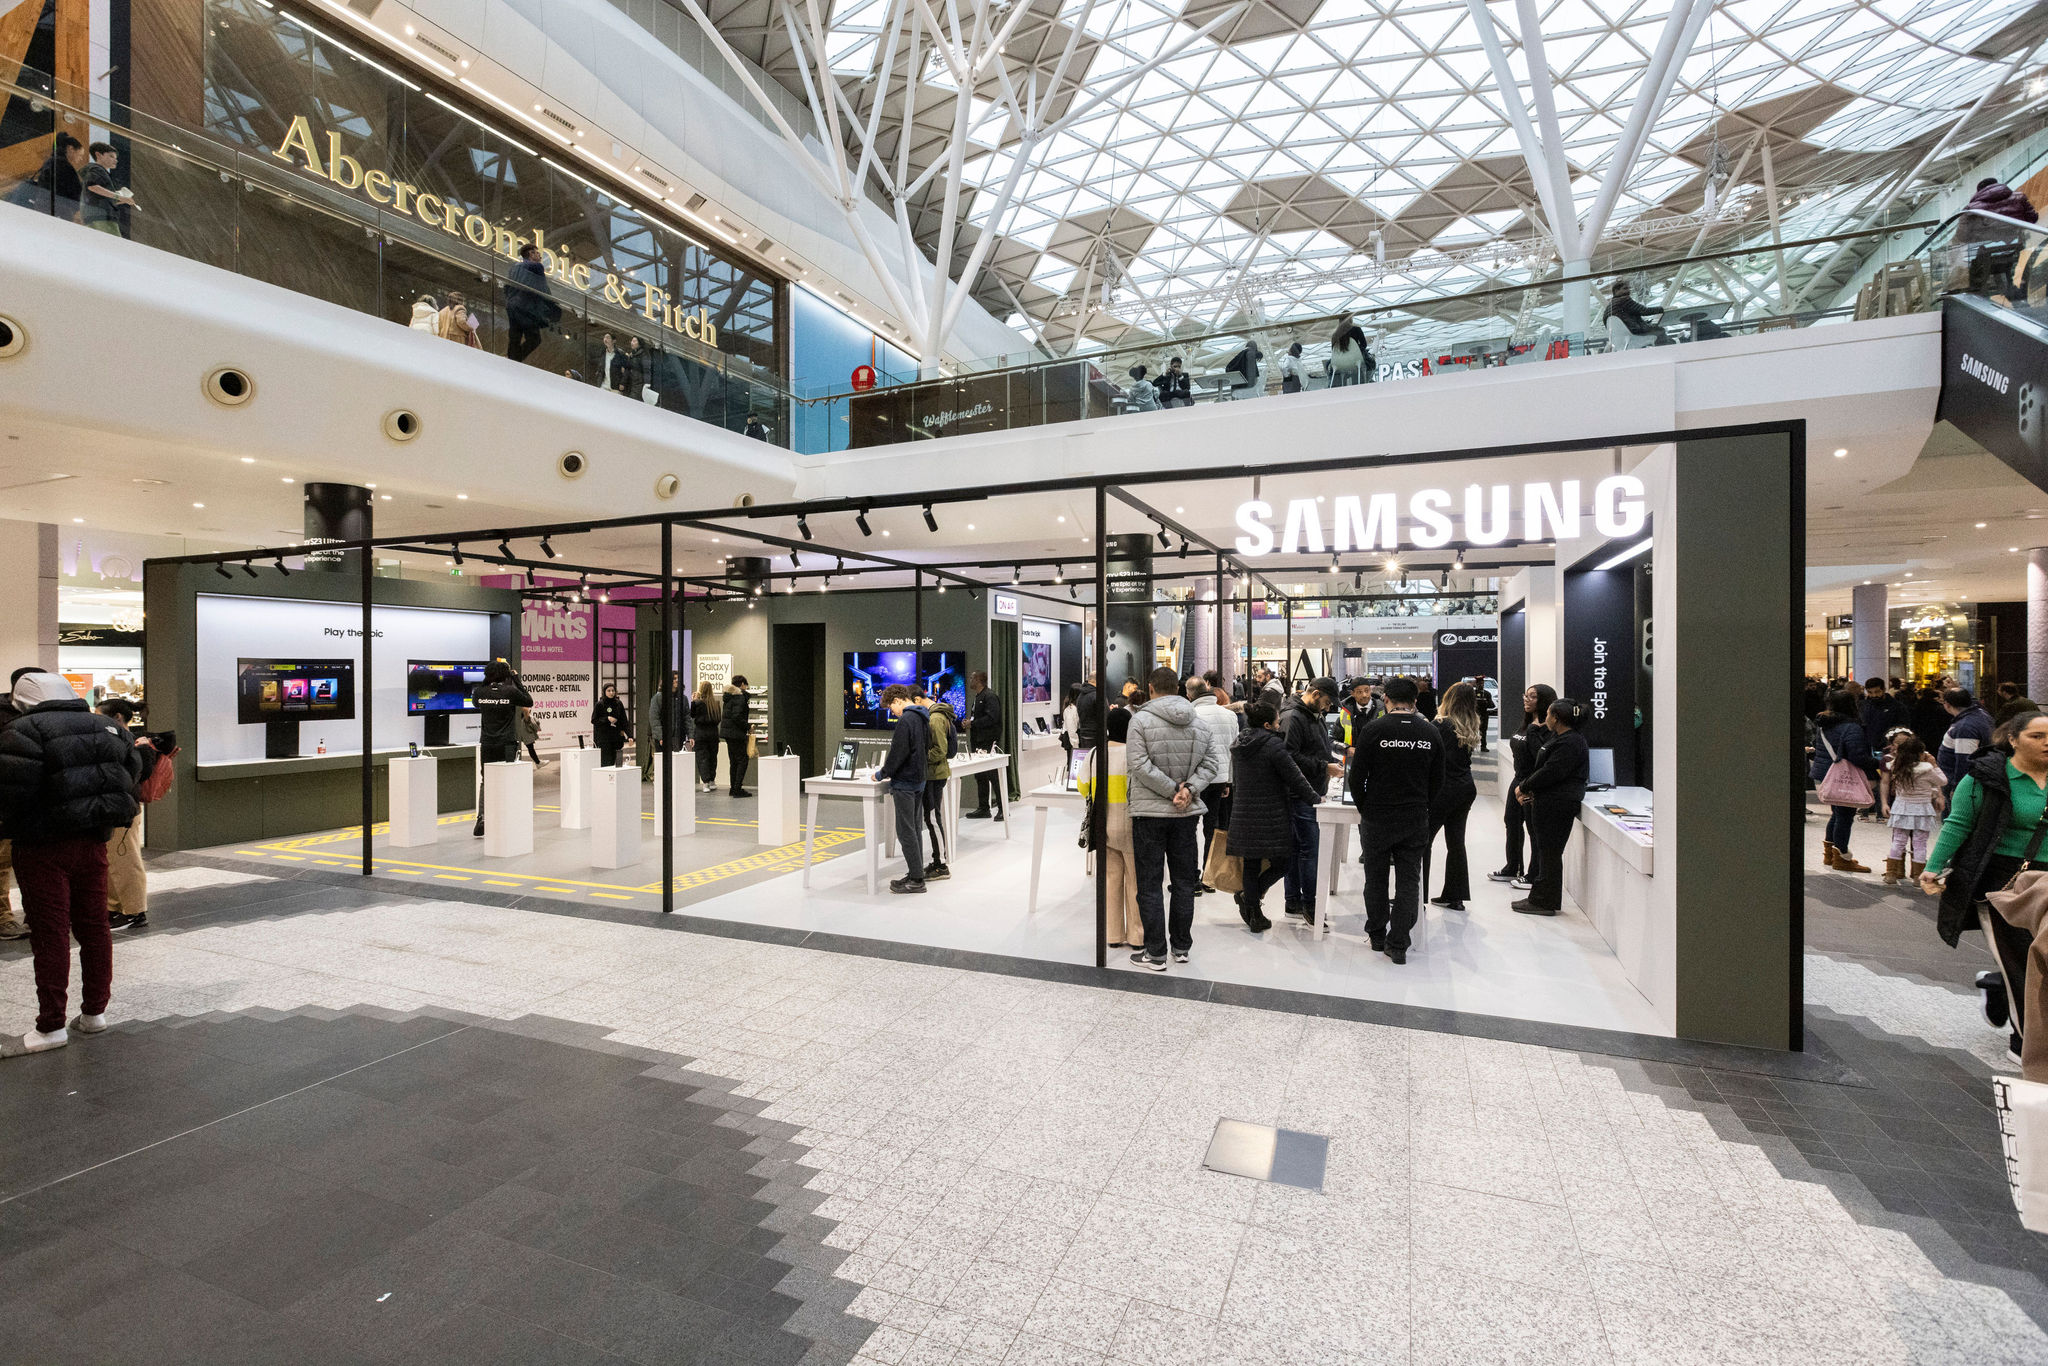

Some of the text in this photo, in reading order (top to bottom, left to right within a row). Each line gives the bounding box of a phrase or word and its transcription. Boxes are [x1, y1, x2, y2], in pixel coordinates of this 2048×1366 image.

[272, 115, 719, 348] Abercrombie & Fitch
[1961, 353, 2010, 395] SAMSUNG
[1235, 474, 1645, 557] SAMSUNG
[521, 609, 588, 642] Mutts
[324, 627, 345, 639] Play
[347, 628, 363, 637] the
[874, 636, 934, 647] Capture the pic
[698, 662, 730, 674] Galaxy
[521, 673, 590, 682] OOMING BOARDING
[699, 672, 724, 681] Photo
[1590, 637, 1609, 719] Join the Epic
[559, 684, 582, 692] RETAIL
[534, 701, 544, 709] 24
[545, 700, 569, 709] HOURS
[576, 699, 589, 707] DAY
[552, 711, 558, 719] A
[558, 710, 578, 719] WEEK
[1379, 739, 1432, 750] Galaxy S23
